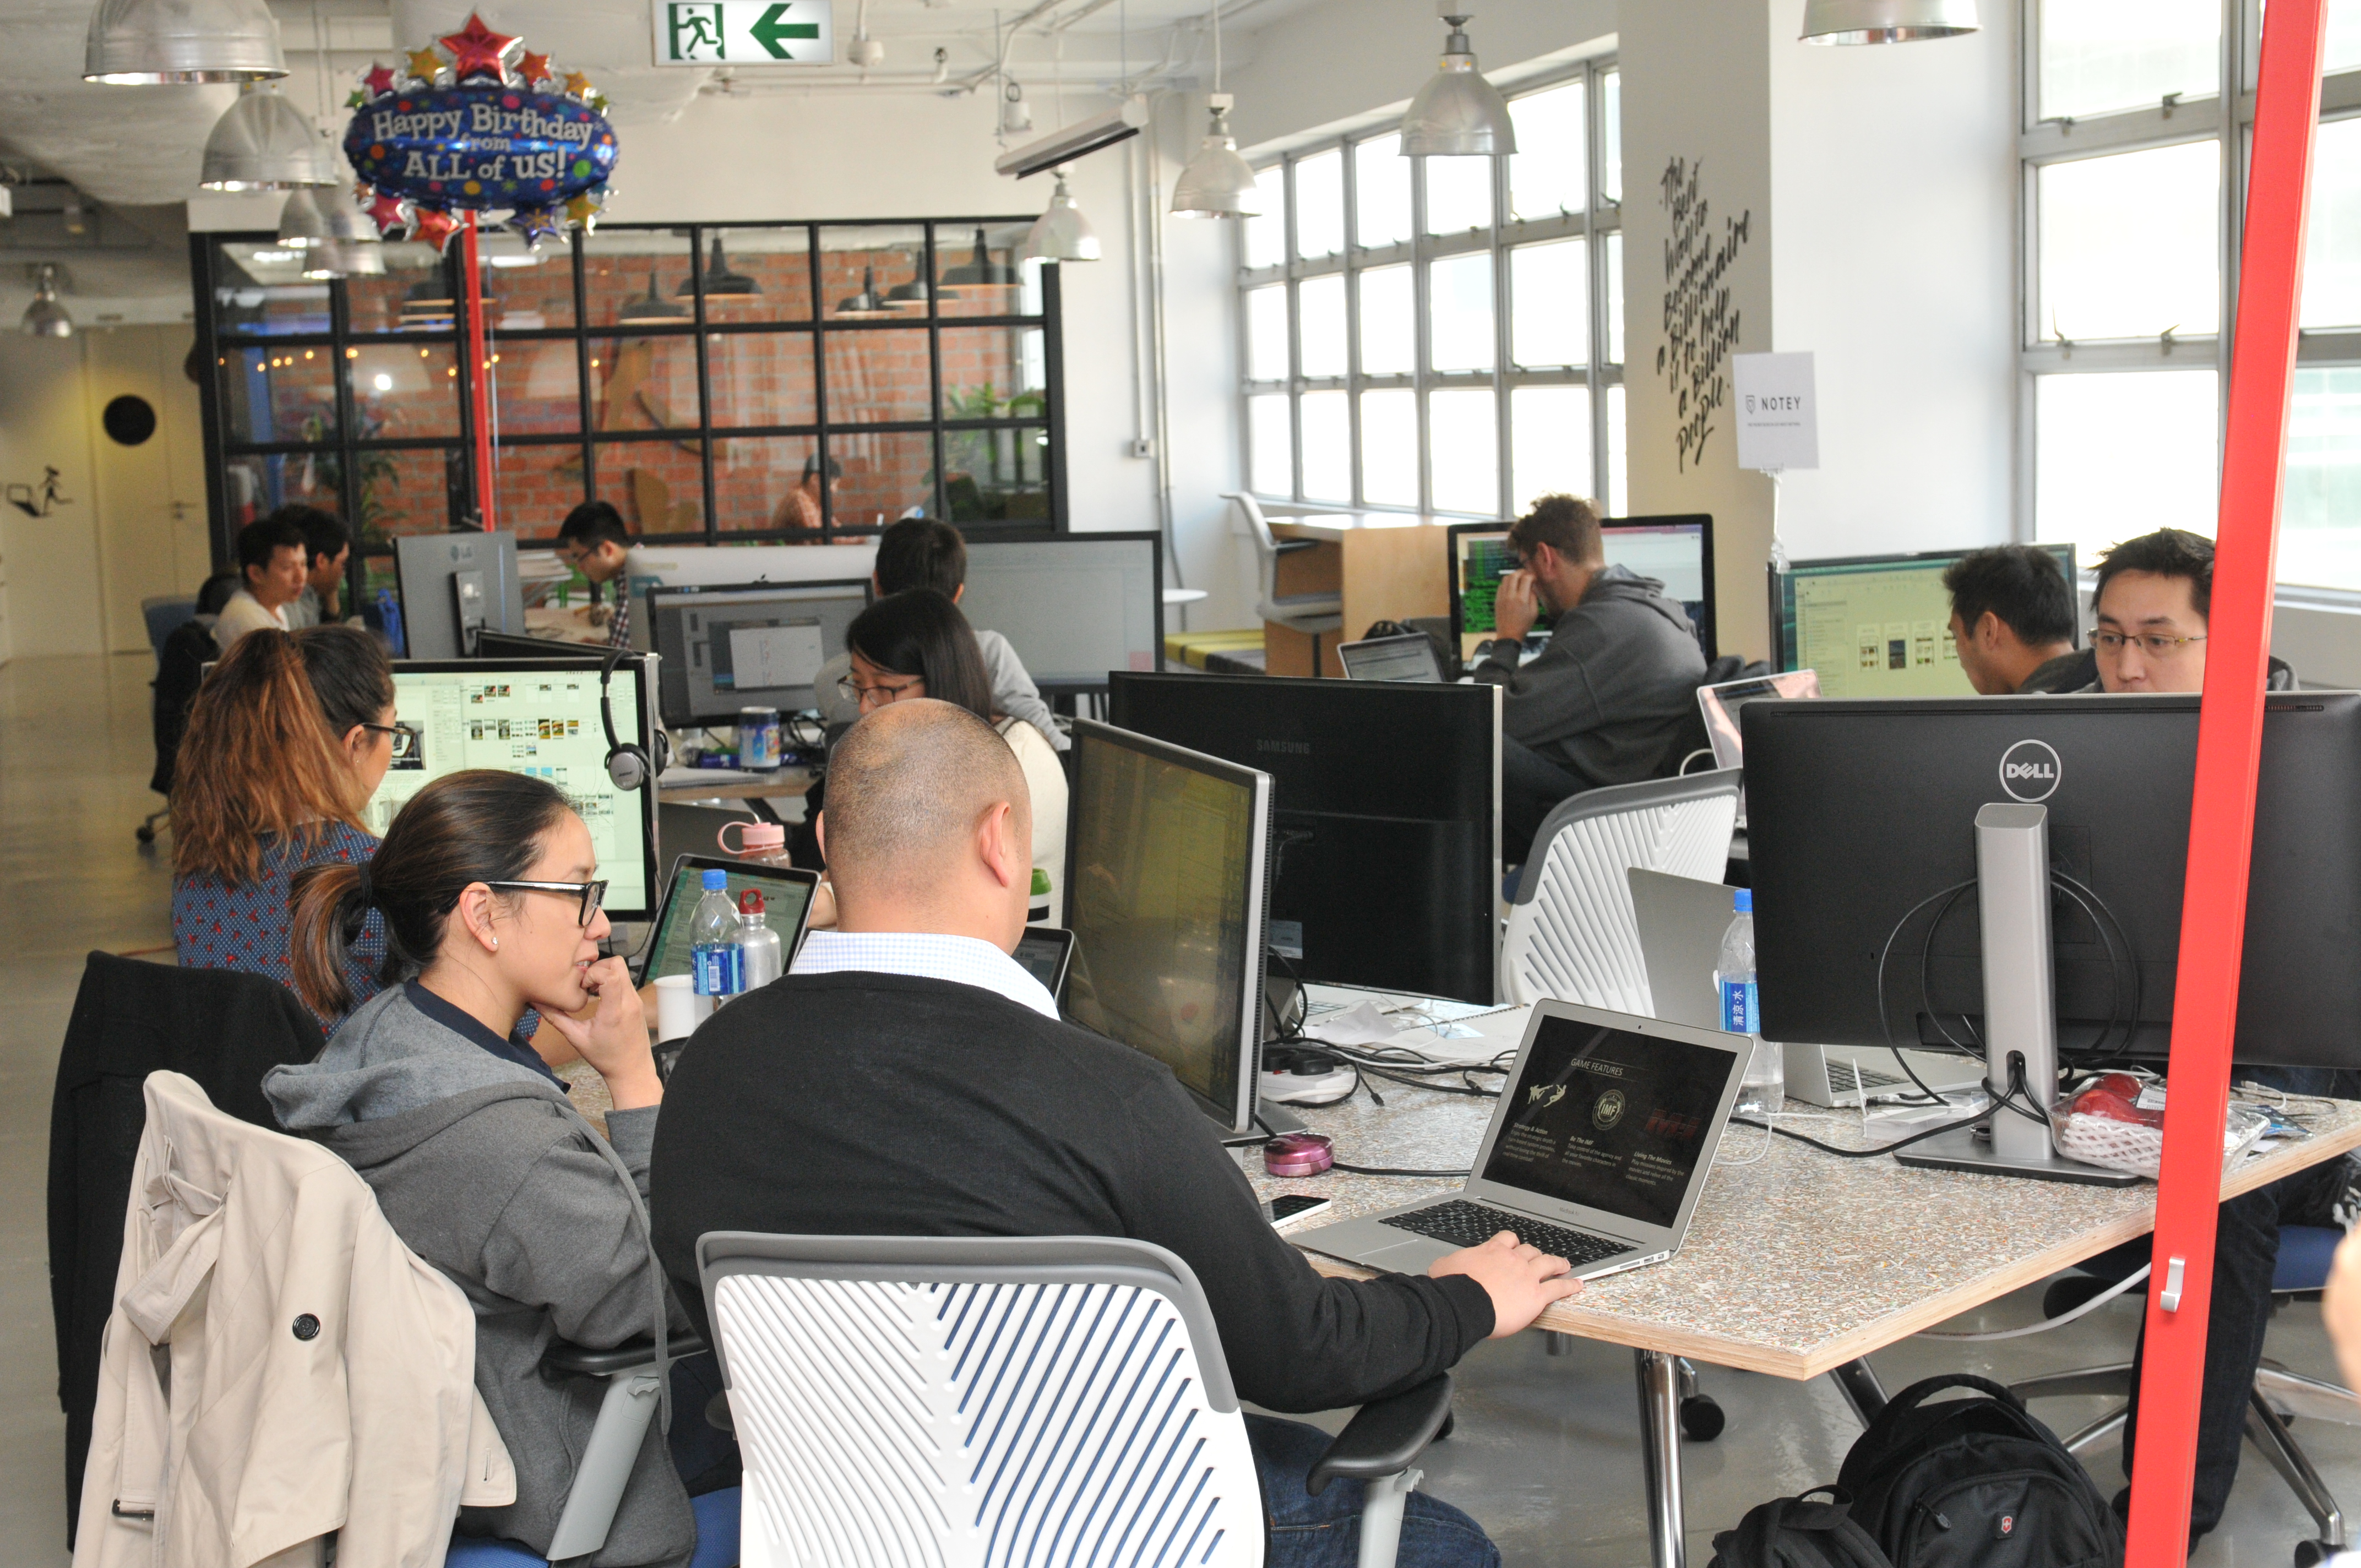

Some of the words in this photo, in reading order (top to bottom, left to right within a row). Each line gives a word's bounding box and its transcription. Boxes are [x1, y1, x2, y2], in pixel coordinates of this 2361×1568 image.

[372, 108, 464, 141] Happy
[470, 103, 594, 151] Birthday
[459, 133, 511, 153] from
[403, 150, 471, 181] ALL
[477, 155, 505, 181] of
[1761, 396, 1801, 411] NOTEY
[1256, 738, 1310, 754] SAMSUNG
[2006, 762, 2054, 780] DELL
[1571, 1058, 1591, 1069] GAME
[1591, 1061, 1624, 1076] FEATURES
[1601, 1103, 1617, 1116] IMF
[1514, 1123, 1531, 1131] Strategy
[1592, 1158, 1612, 1166] characters
[1634, 1151, 1647, 1160] Living
[1656, 1156, 1672, 1165] Movies
